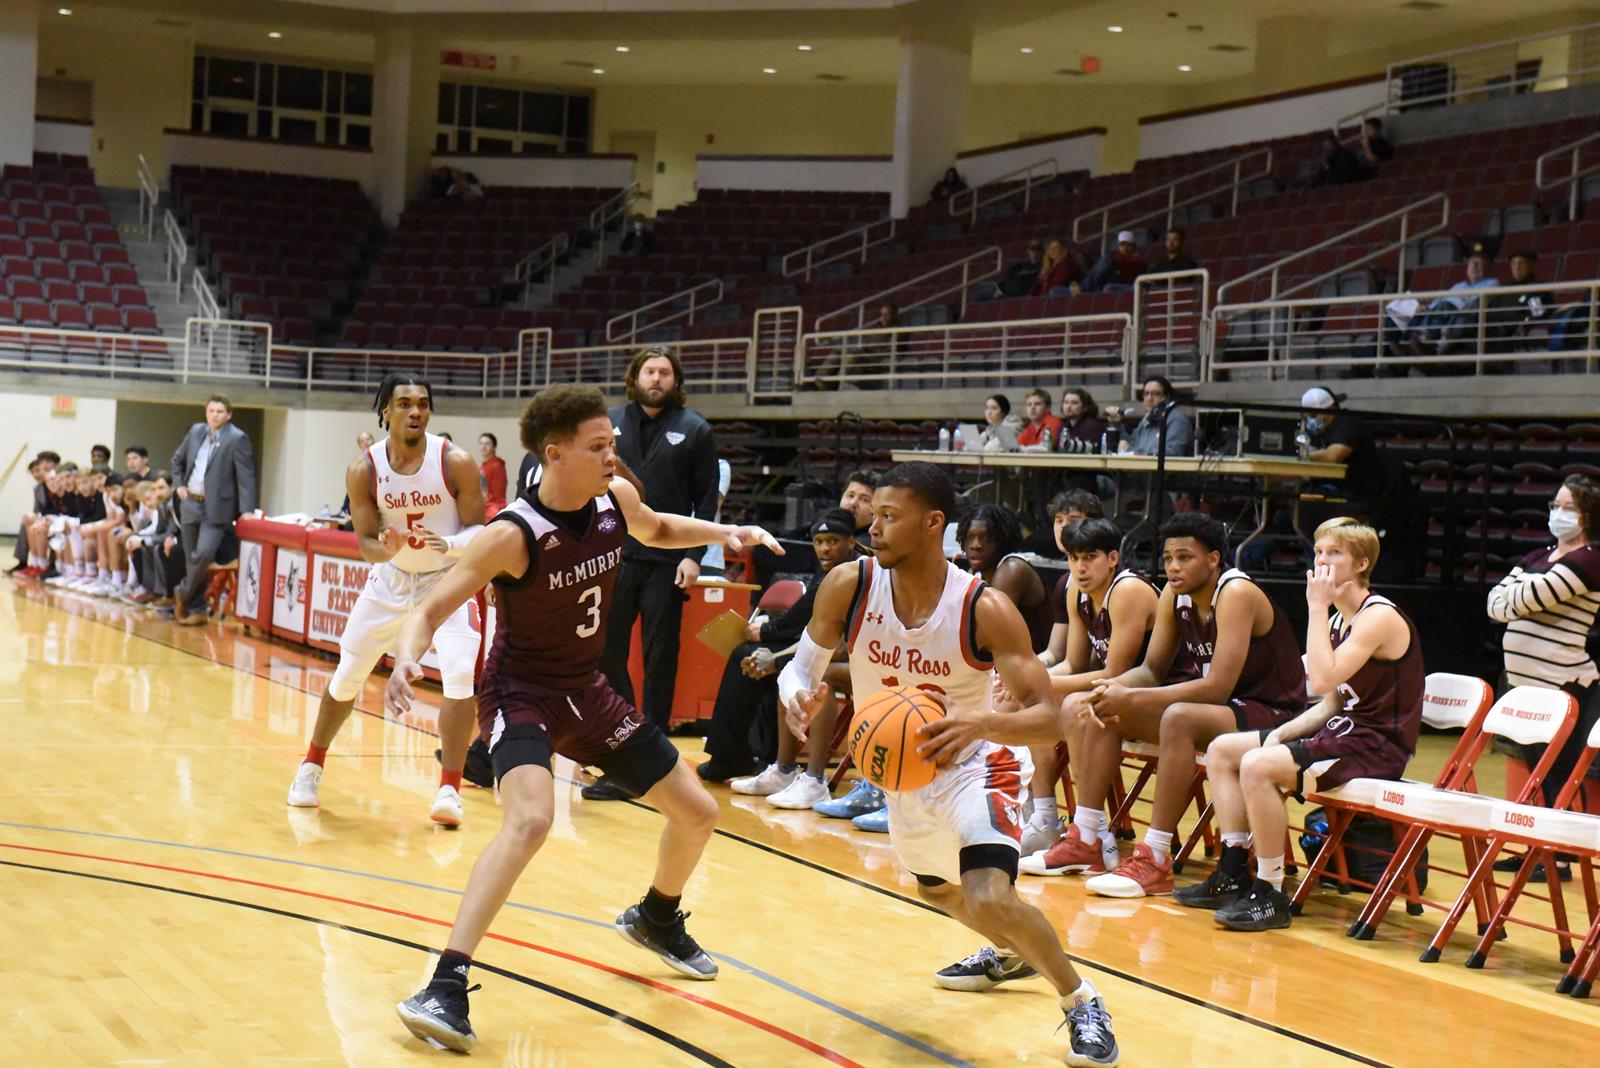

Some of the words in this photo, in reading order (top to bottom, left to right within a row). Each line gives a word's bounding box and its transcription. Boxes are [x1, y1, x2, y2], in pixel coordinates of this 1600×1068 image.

[384, 492, 408, 509] Sul
[410, 490, 441, 507] Ross
[406, 512, 426, 550] 5
[321, 561, 340, 586] SUL
[575, 585, 602, 639] 3
[867, 639, 902, 669] Sul
[906, 648, 951, 677] Ross
[1383, 789, 1405, 806] LOBOS
[1504, 811, 1536, 828] LOBOS
